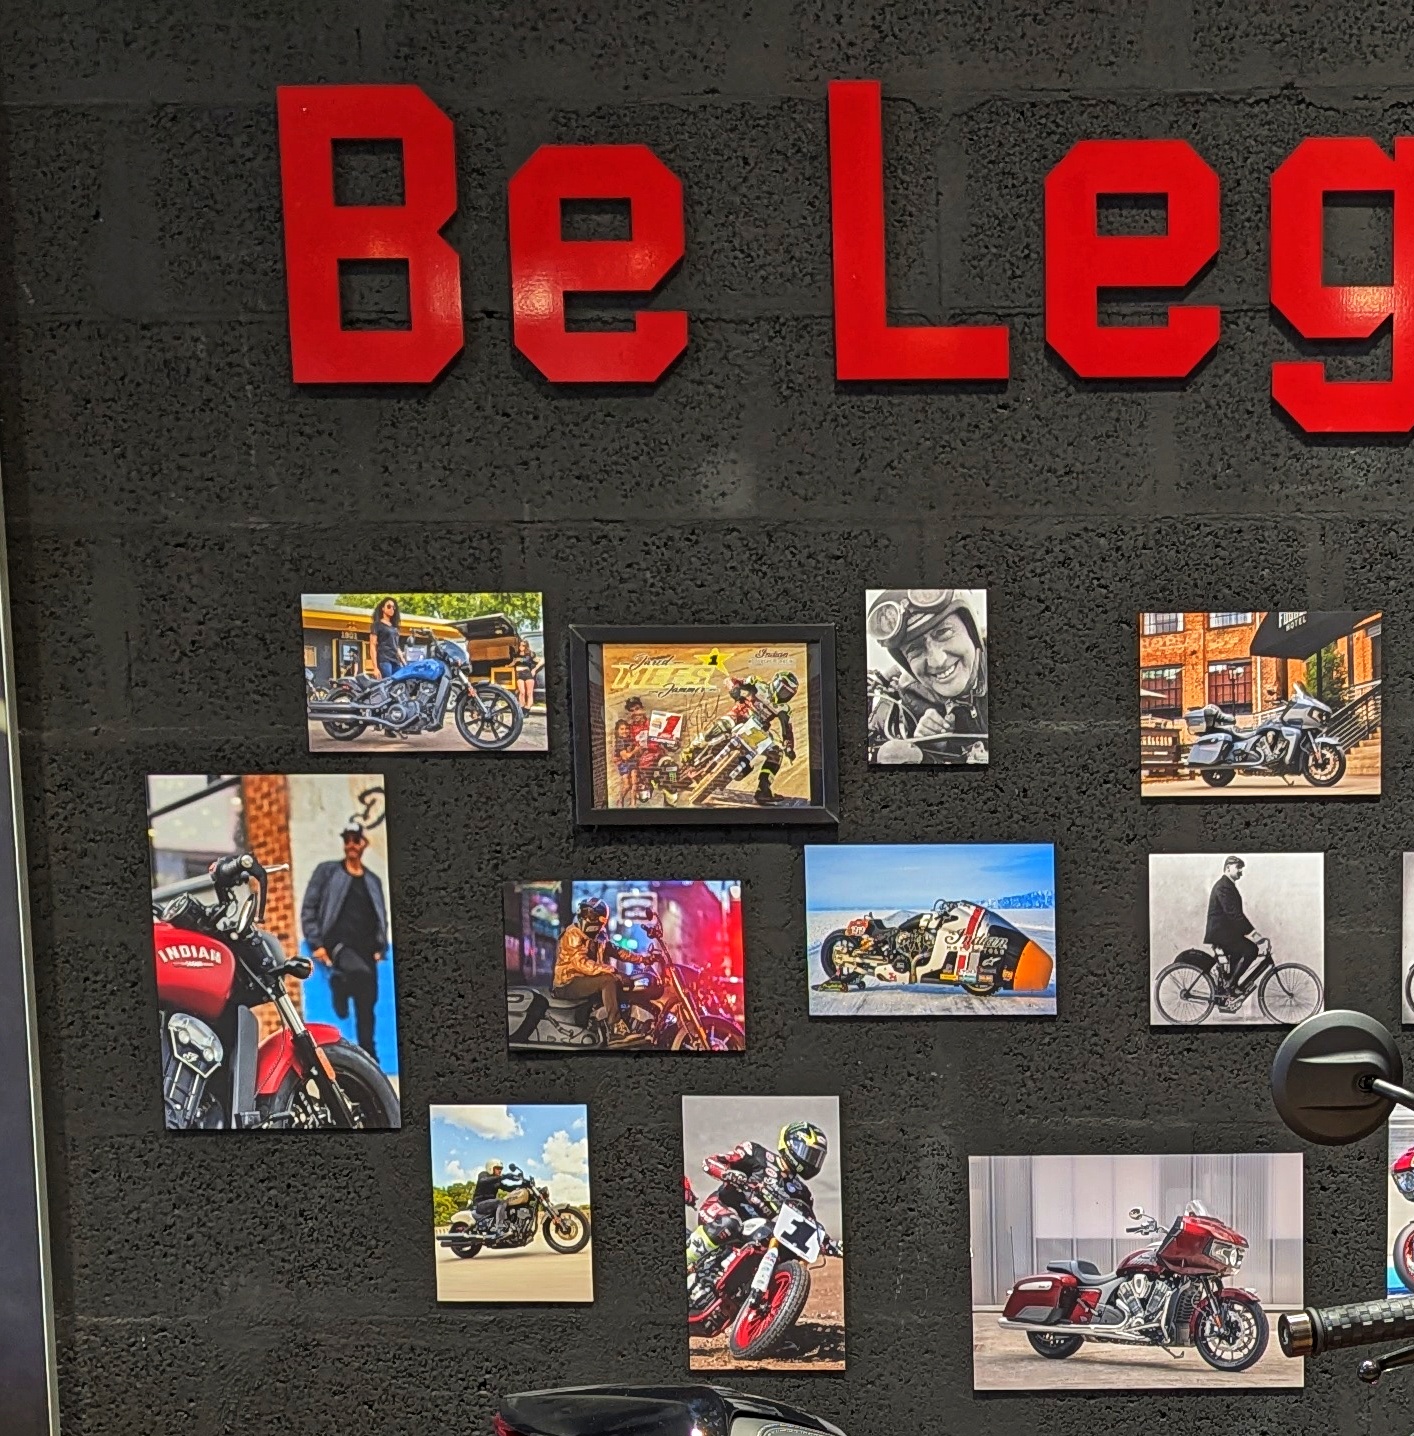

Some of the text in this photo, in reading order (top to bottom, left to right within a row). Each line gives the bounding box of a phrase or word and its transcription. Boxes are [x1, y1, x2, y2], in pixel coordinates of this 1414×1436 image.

[277, 85, 689, 385] Be
[708, 655, 719, 665] 1
[658, 715, 681, 740] 1
[158, 945, 222, 965] INDIAN
[780, 1218, 817, 1255] 1
